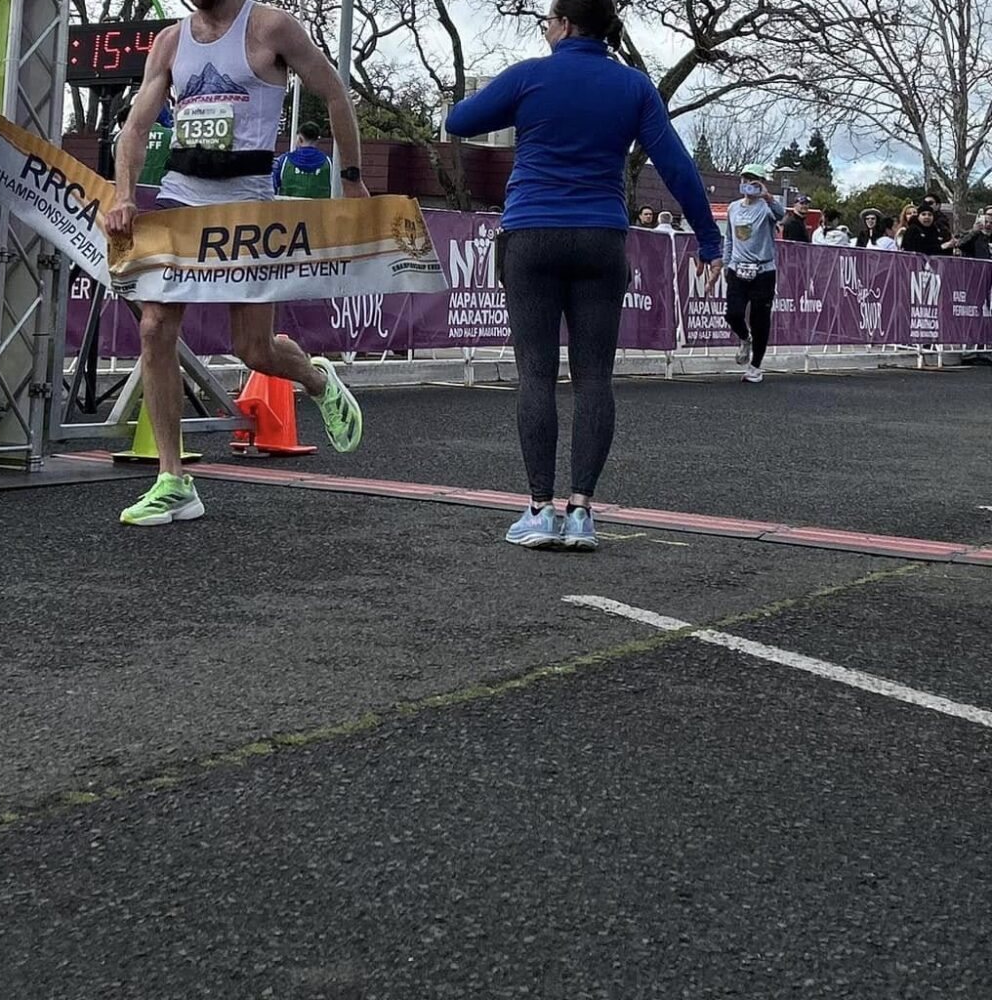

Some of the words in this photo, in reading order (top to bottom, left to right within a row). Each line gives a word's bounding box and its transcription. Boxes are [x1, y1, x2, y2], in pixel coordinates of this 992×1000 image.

[181, 119, 228, 138] 1330
[20, 153, 100, 232] RRCA
[70, 232, 105, 267] EVENT
[198, 222, 311, 263] RRCA
[162, 263, 295, 283] CHAMPIONSHIP
[299, 260, 351, 278] EVENT
[449, 292, 478, 308] NAPA
[479, 292, 506, 308] VALLE
[449, 327, 463, 338] AND
